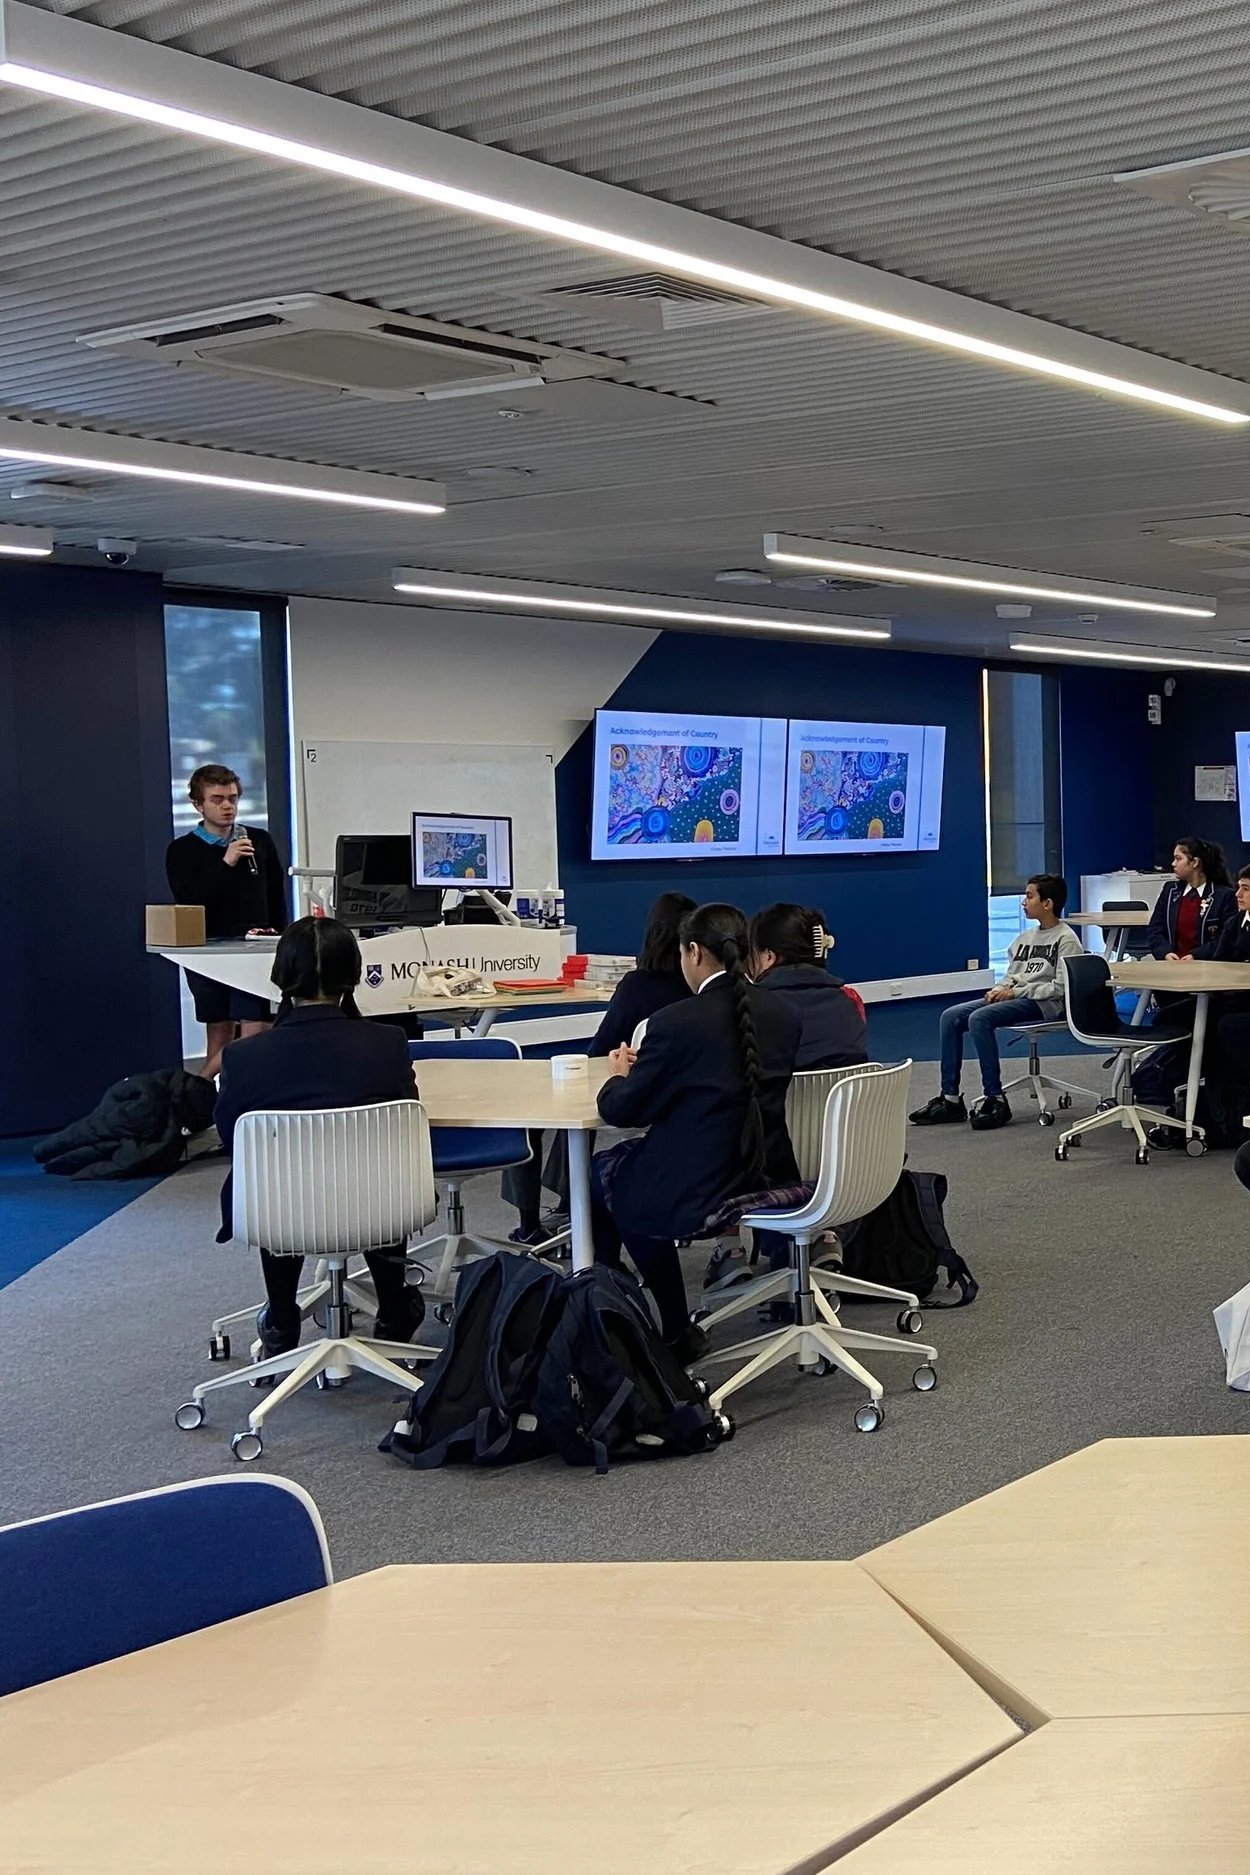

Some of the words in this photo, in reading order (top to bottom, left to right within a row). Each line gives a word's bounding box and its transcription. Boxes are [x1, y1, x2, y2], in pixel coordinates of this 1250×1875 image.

[609, 727, 680, 738] Acknowledgement
[681, 729, 689, 737] of
[690, 730, 719, 740] Country
[310, 752, 317, 763] 2
[472, 954, 541, 972] University
[1024, 961, 1045, 974] 1970
